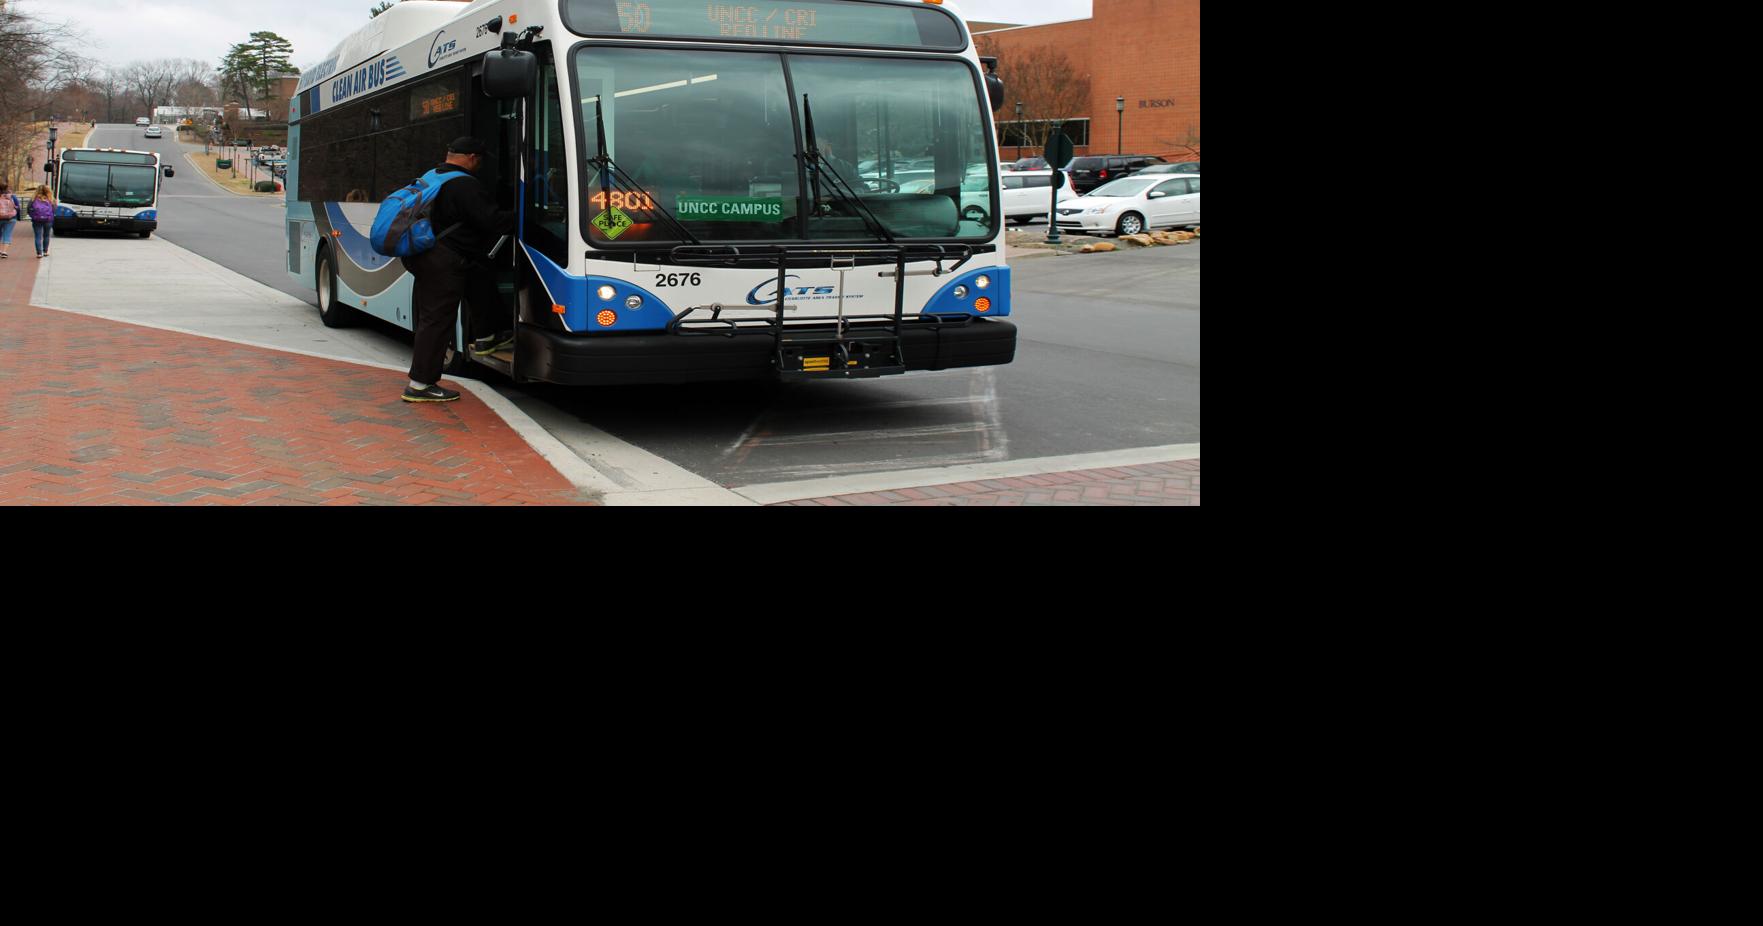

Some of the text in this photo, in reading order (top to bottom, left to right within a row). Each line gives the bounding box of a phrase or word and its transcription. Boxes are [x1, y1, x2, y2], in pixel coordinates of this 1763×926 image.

[707, 4, 758, 23] UNCC
[784, 9, 817, 27] CRI
[332, 74, 353, 103] CLEAN
[353, 66, 367, 95] AIR
[368, 59, 386, 89] BUS
[1138, 97, 1176, 108] BURSON
[591, 191, 655, 210] 4801
[678, 202, 781, 215] UNCC CAMPUS
[655, 272, 701, 287] 2676
